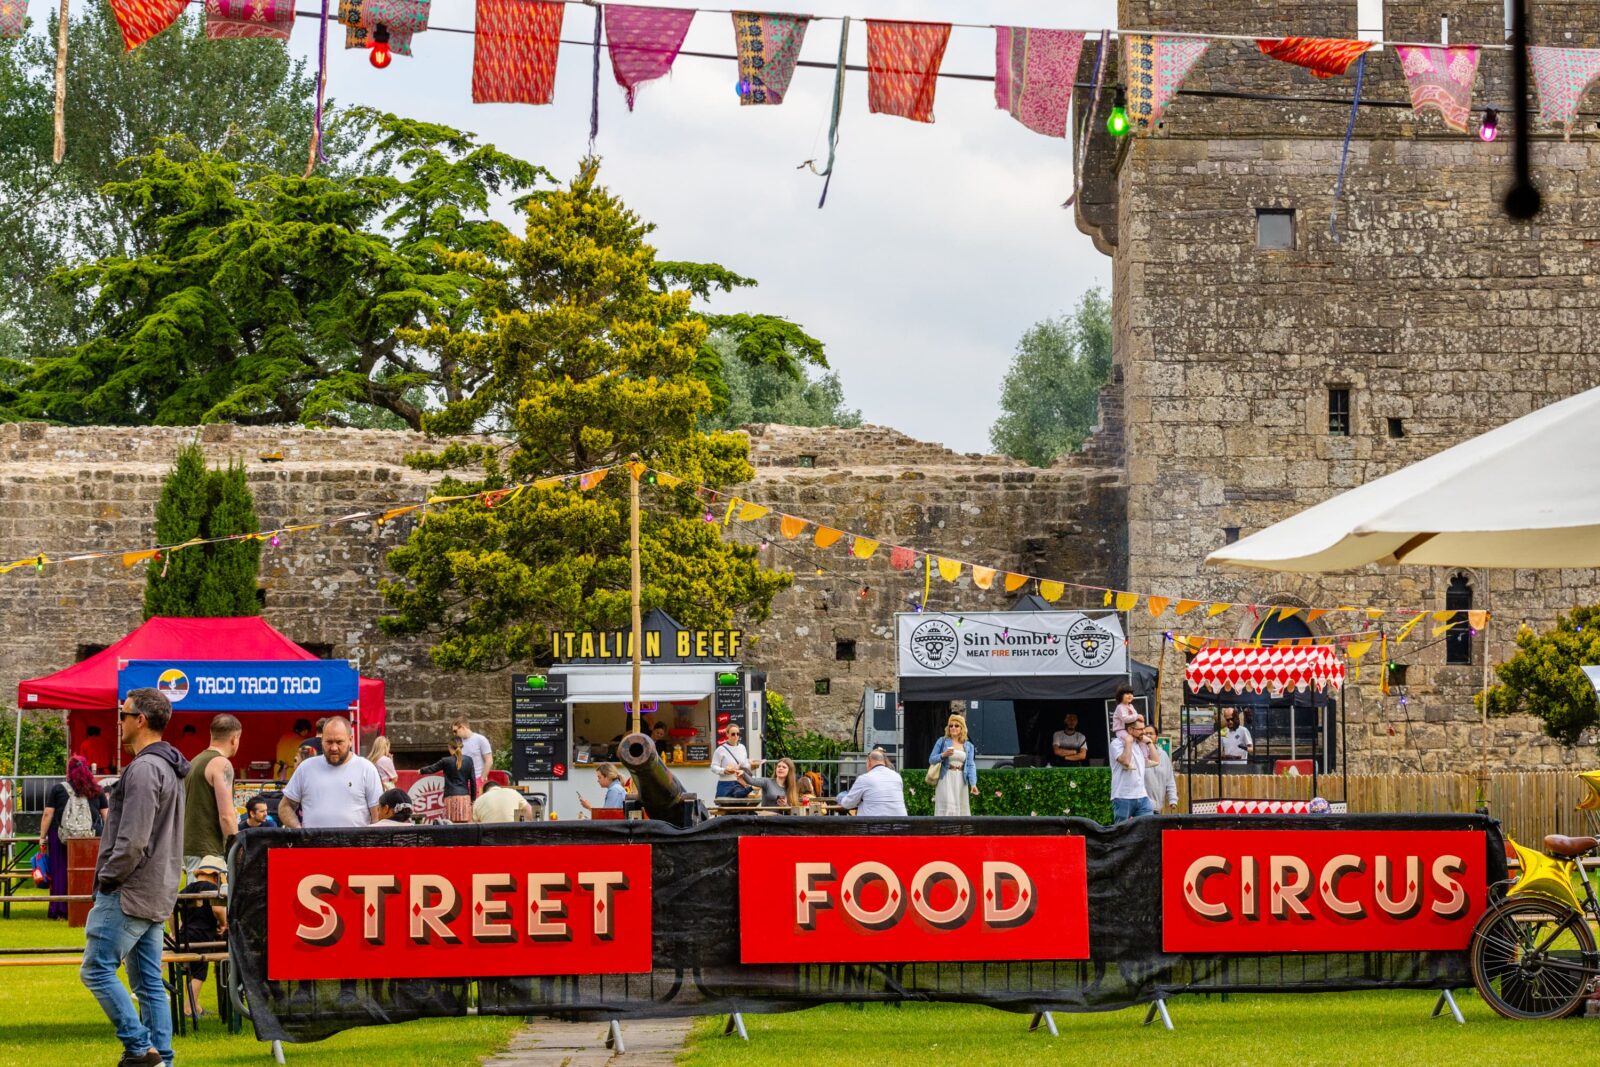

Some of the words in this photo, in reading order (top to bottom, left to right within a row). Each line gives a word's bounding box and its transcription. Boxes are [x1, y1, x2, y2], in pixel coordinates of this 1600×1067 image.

[675, 629, 742, 659] BEEF
[963, 631, 990, 646] Sin
[966, 649, 989, 657] MEAT
[991, 649, 1010, 657] FIRE
[1011, 648, 1030, 657] FISH
[1032, 648, 1059, 657] TACOS
[195, 676, 236, 695] TACO
[238, 676, 279, 695] TACO
[281, 676, 321, 695] TACO
[793, 859, 1036, 931] FOOD
[1182, 853, 1470, 921] CIRCUS
[294, 870, 629, 946] STREET
